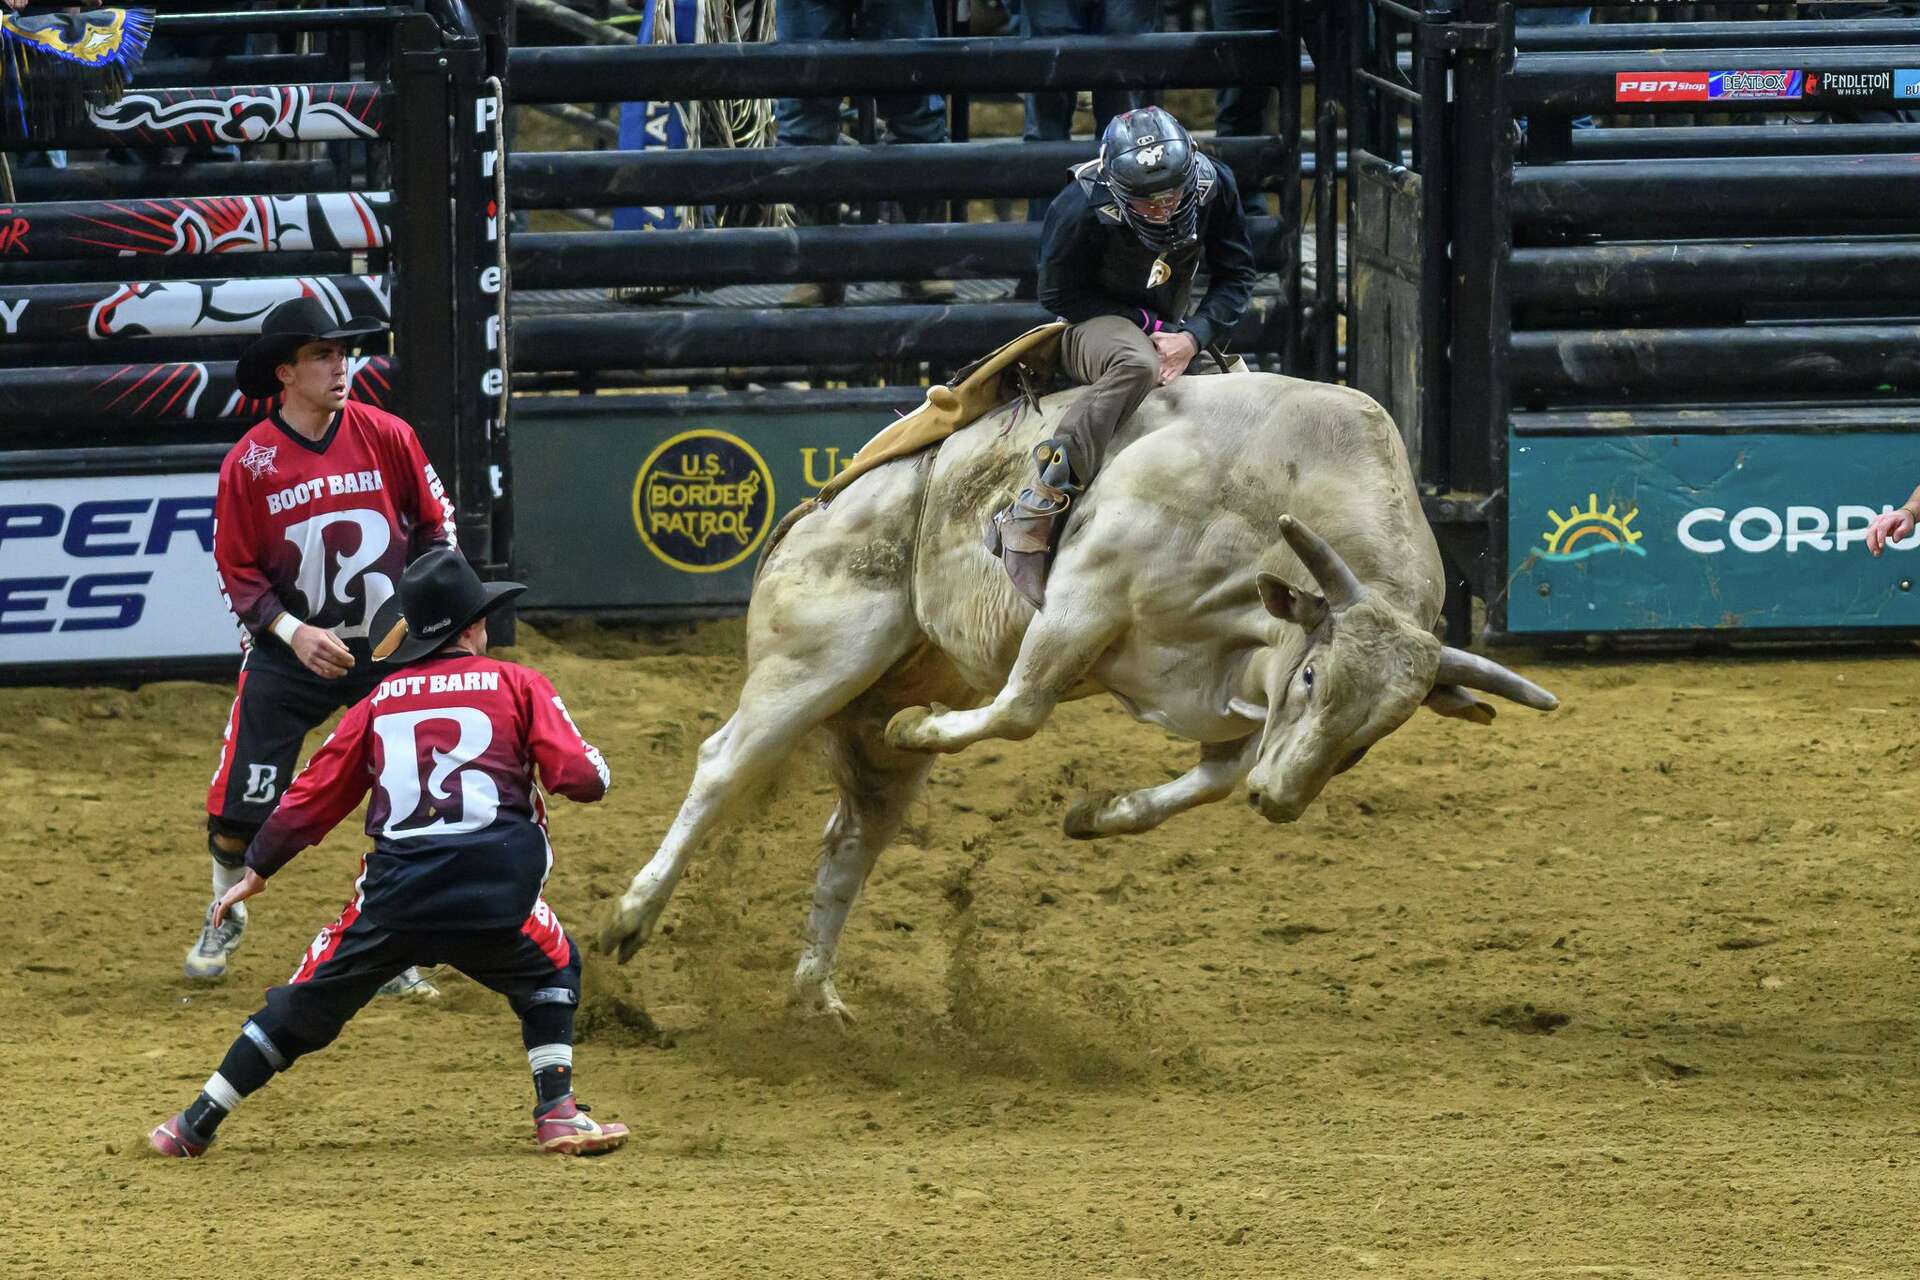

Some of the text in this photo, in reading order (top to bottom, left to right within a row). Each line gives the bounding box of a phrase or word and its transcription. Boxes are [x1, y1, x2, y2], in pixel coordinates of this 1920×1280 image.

[1677, 82, 1706, 92] Shop
[1723, 72, 1787, 91] BEATBOX
[1823, 72, 1890, 90] PENDLETON
[1837, 88, 1874, 96] WHISKY
[681, 453, 726, 476] U.S.
[266, 470, 384, 516] BOOT BARN
[651, 484, 753, 506] BORDER
[651, 511, 753, 534] PATROL
[371, 672, 499, 707] OOT BARN
